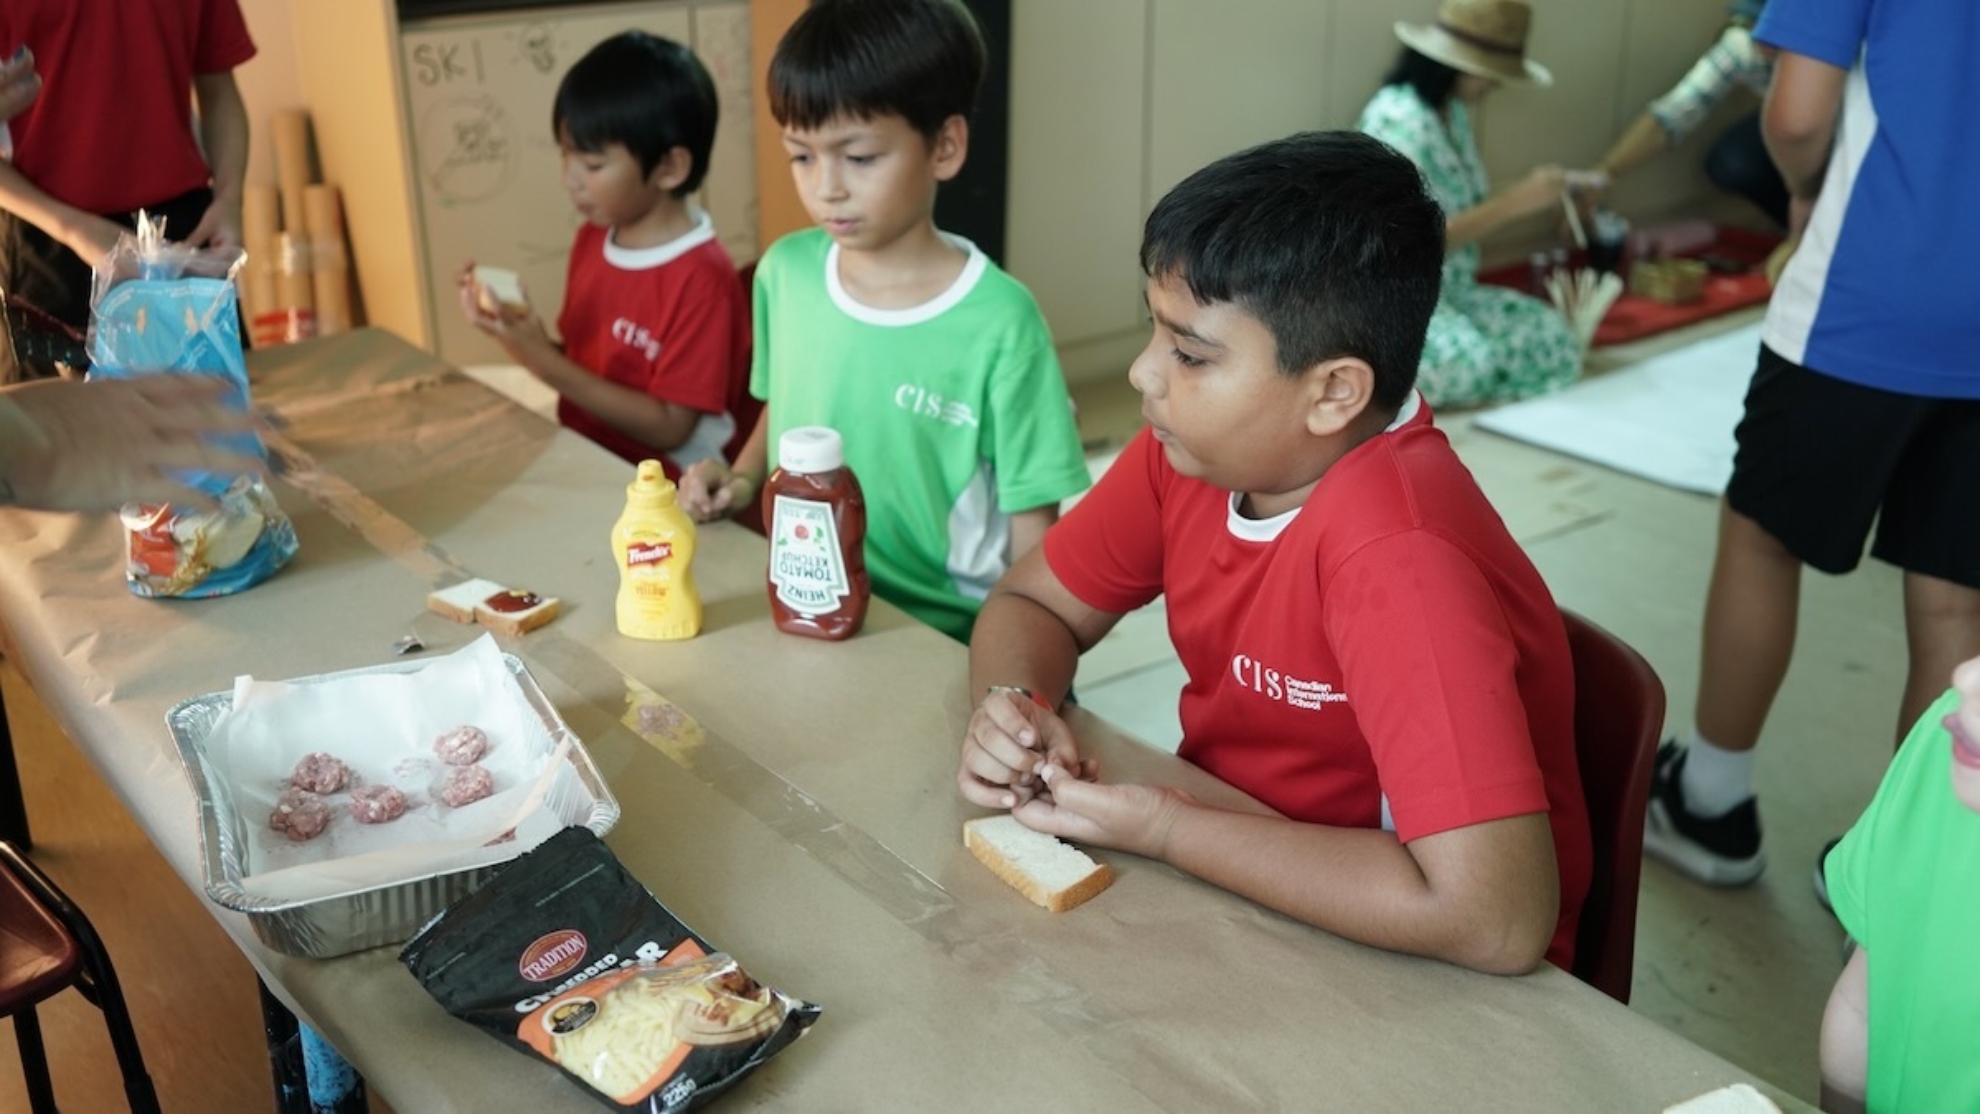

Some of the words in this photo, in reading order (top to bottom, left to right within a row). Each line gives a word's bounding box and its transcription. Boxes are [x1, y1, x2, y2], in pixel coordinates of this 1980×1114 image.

[895, 384, 942, 418] CIS
[779, 561, 832, 581] TOMATO
[787, 585, 826, 601] HEINZ
[1232, 654, 1283, 700] CIS
[524, 935, 586, 979] TRADITION
